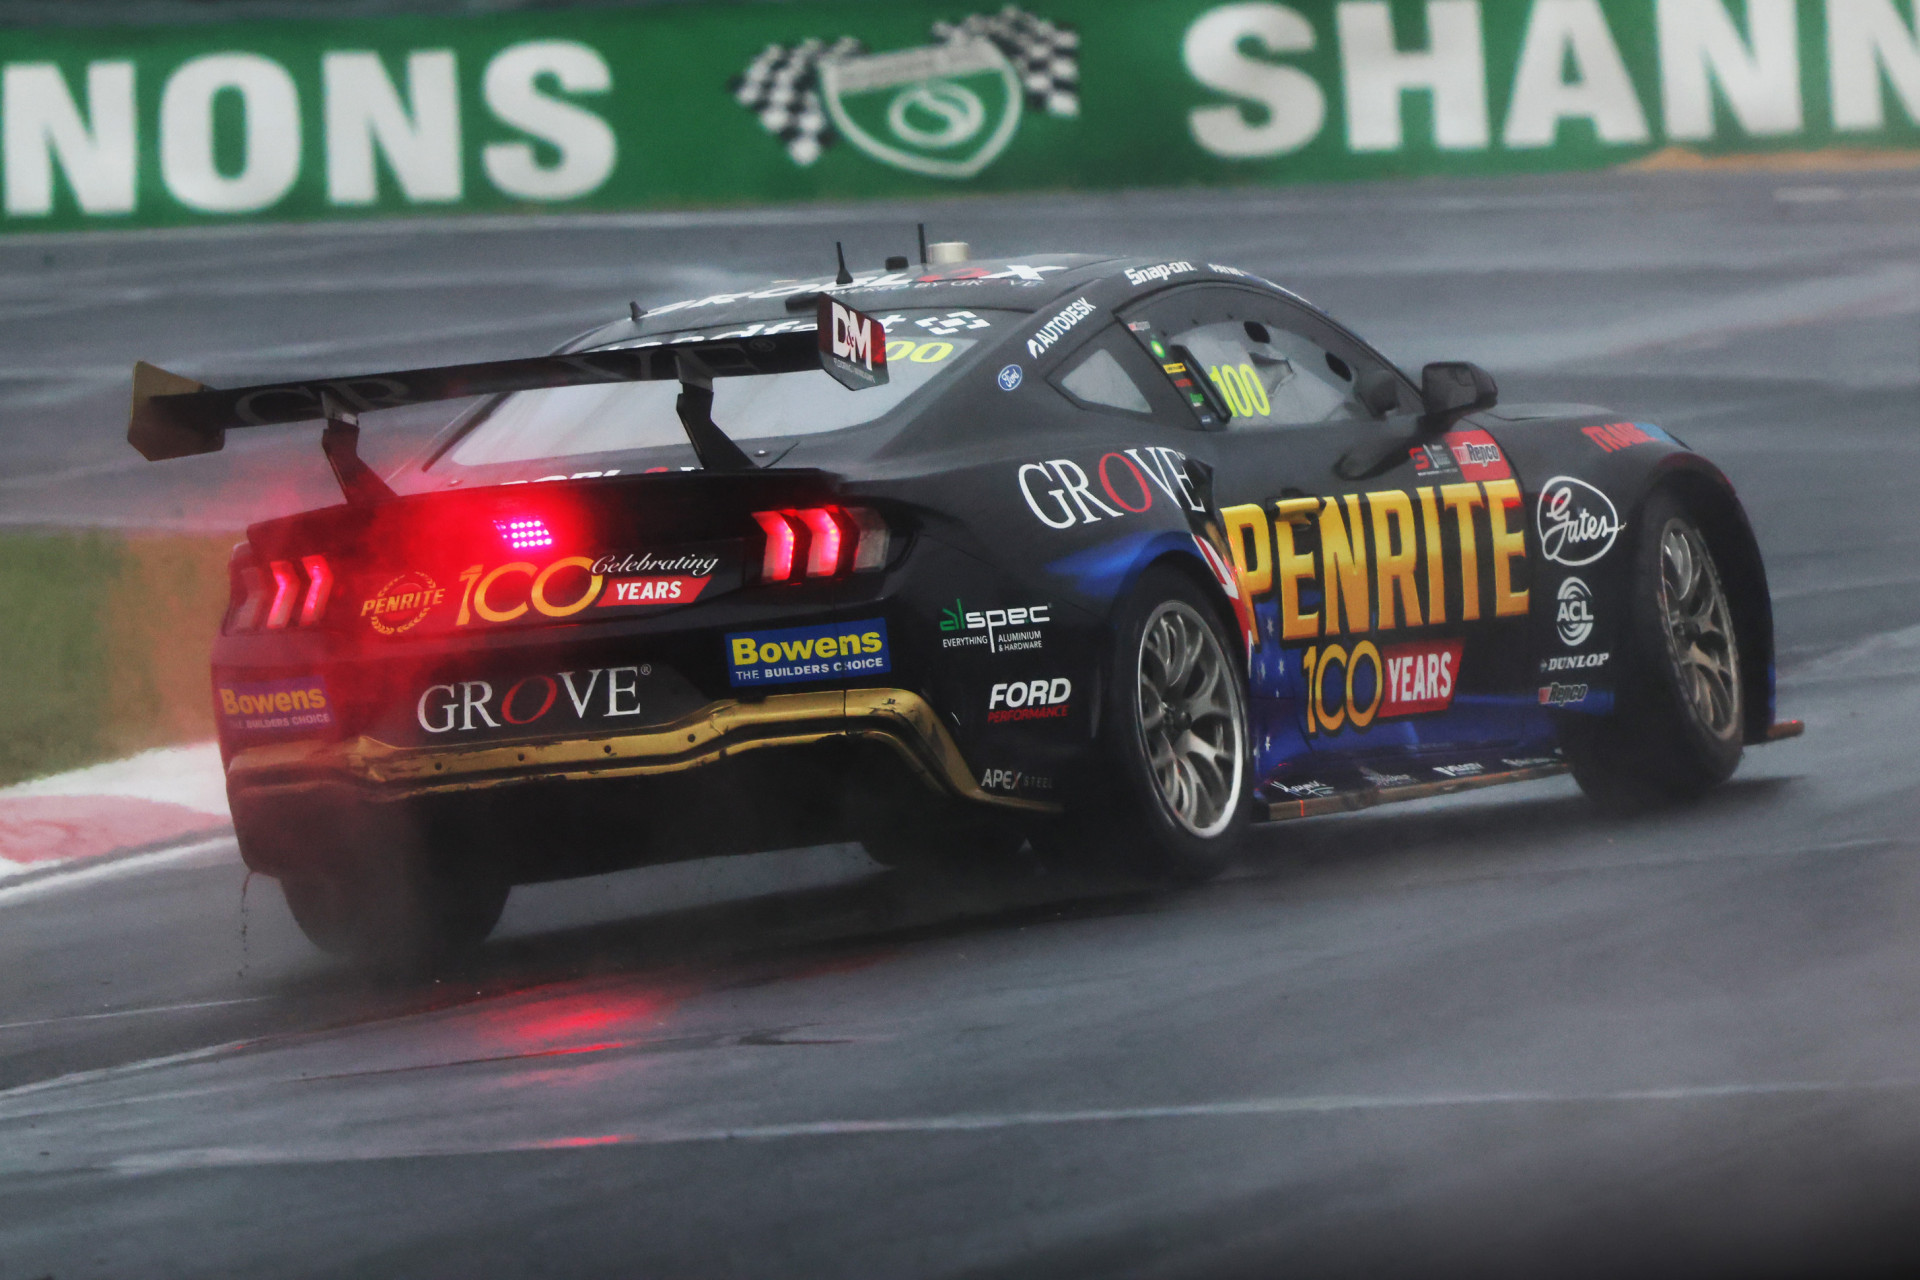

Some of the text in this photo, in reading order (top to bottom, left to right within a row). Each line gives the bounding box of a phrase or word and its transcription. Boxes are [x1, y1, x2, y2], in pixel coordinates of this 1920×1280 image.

[3, 40, 617, 216] NONS
[1124, 260, 1195, 286] Snap-on
[1038, 297, 1097, 348] AUTODESK
[832, 301, 873, 372] D&M
[886, 340, 954, 363] 00
[1001, 367, 1021, 388] Ford
[1209, 363, 1271, 418] 100
[1543, 486, 1609, 560] Gates
[592, 552, 719, 576] Celebrating
[1219, 478, 1531, 646] PENRITE
[360, 588, 446, 617] PENRITE
[616, 580, 683, 601] YEARS
[1556, 600, 1595, 622] ACL
[731, 631, 883, 666] Bowens
[942, 634, 989, 648] EVERYTHING
[998, 630, 1042, 643] ALUMINIUM
[1004, 640, 1043, 652] HARDWARE
[736, 657, 884, 681] THE BUILDERS CHOICE
[1547, 652, 1610, 671] DUNLOP
[1303, 640, 1384, 734] 100
[1387, 651, 1453, 703] YEARS
[219, 688, 326, 715] Bowens
[989, 677, 1072, 710] FORD
[291, 713, 330, 726] CHOICE
[987, 704, 1070, 724] PERFORMANCE
[981, 768, 1022, 790] APEX
